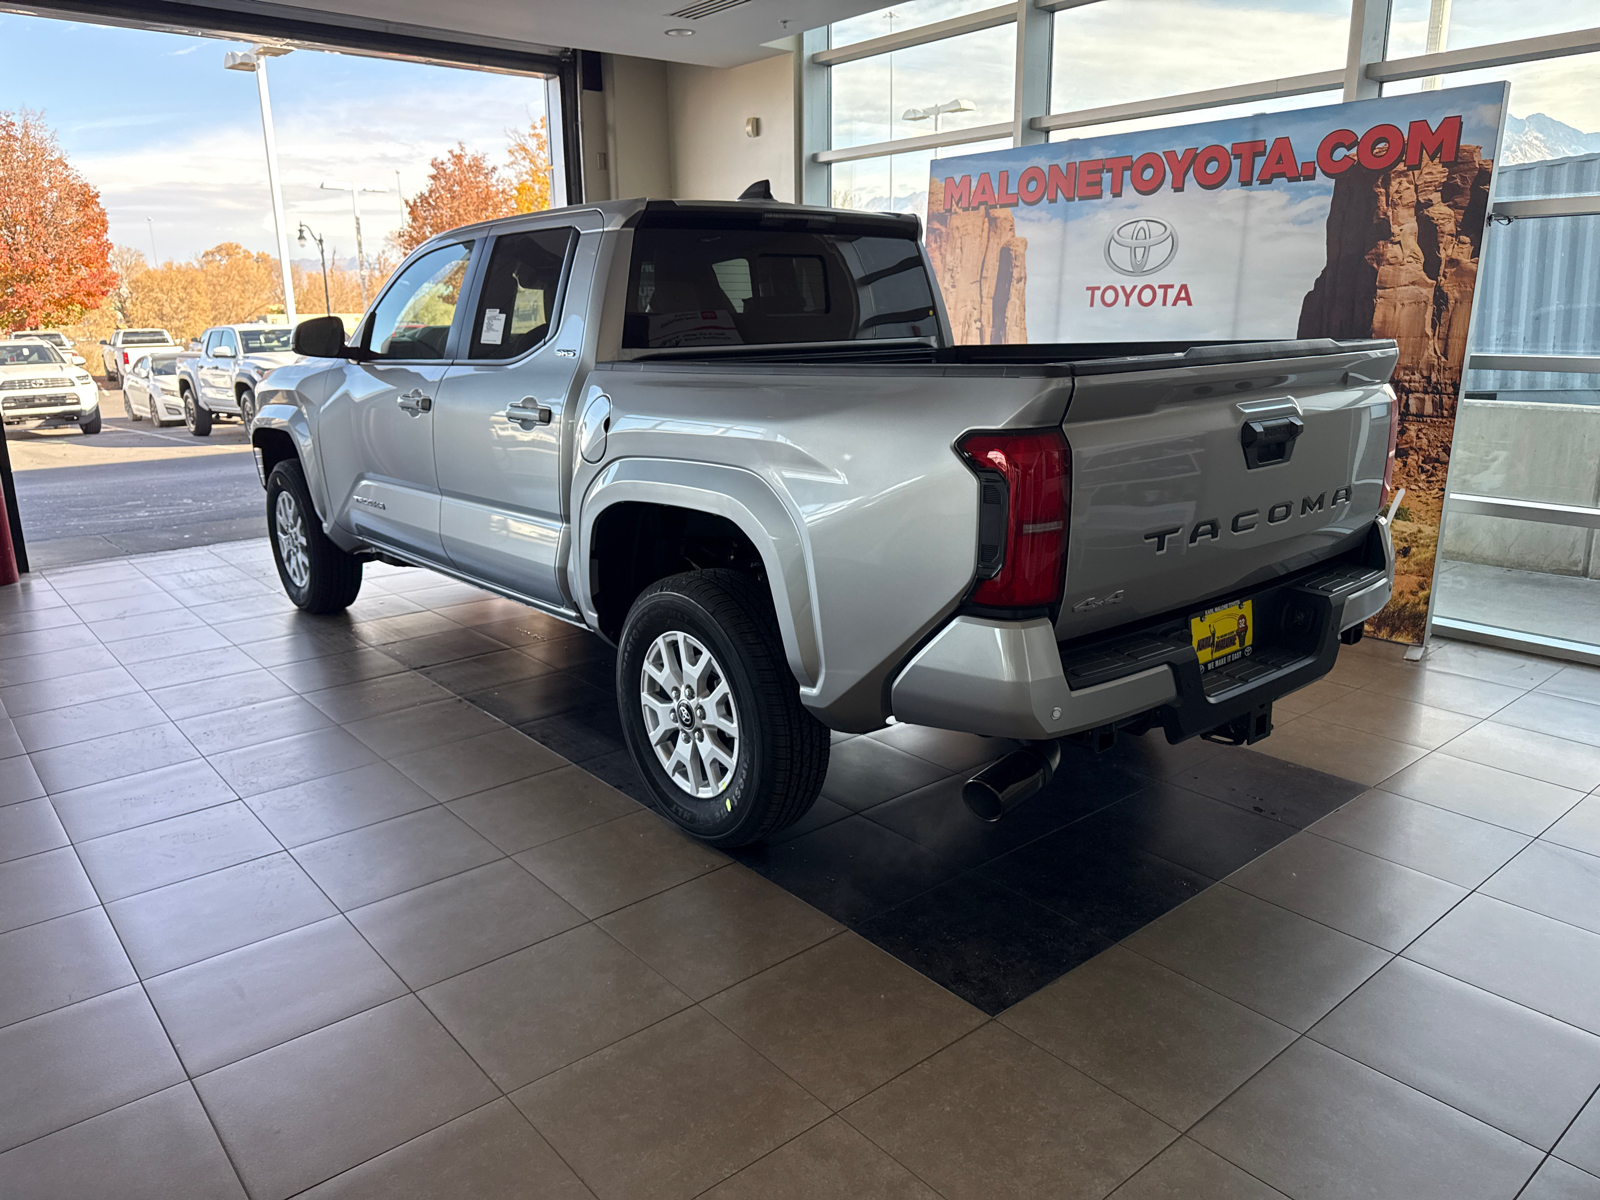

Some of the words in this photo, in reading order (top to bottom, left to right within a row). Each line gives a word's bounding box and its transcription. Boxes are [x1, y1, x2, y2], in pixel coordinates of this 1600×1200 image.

[943, 115, 1463, 213] MALONETOYOTA.COM
[1085, 283, 1193, 308] TOYOTA
[1144, 485, 1352, 555] TACOMA
[1238, 619, 1245, 628] 32
[1208, 662, 1214, 670] WE
[1215, 657, 1226, 668] MAKE
[1232, 651, 1242, 661] EASY
